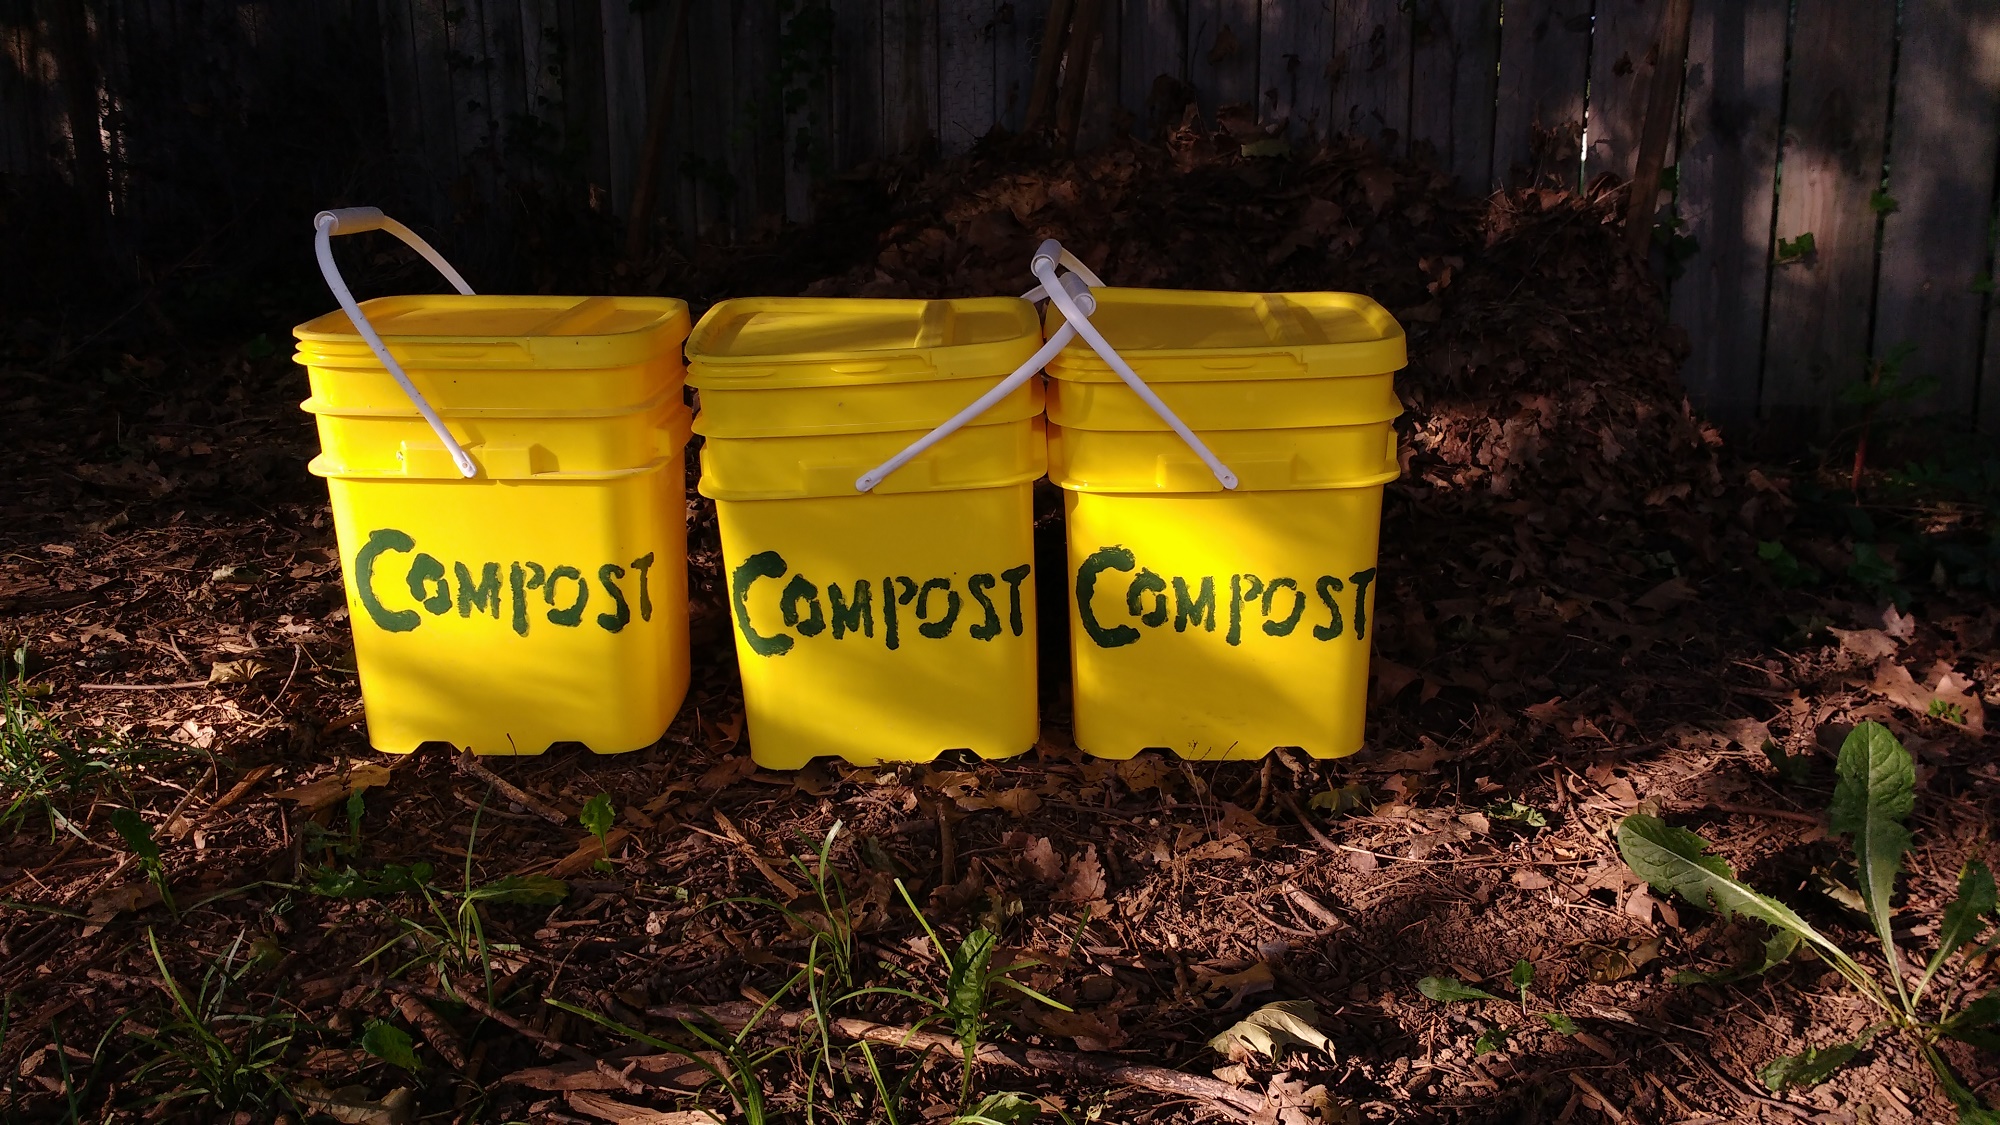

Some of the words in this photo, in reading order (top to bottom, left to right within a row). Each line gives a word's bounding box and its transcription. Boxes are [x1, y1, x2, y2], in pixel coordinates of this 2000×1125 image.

[355, 528, 655, 637] COMPOST
[732, 550, 1031, 657] COMPOST
[1075, 544, 1376, 648] COMPOST
